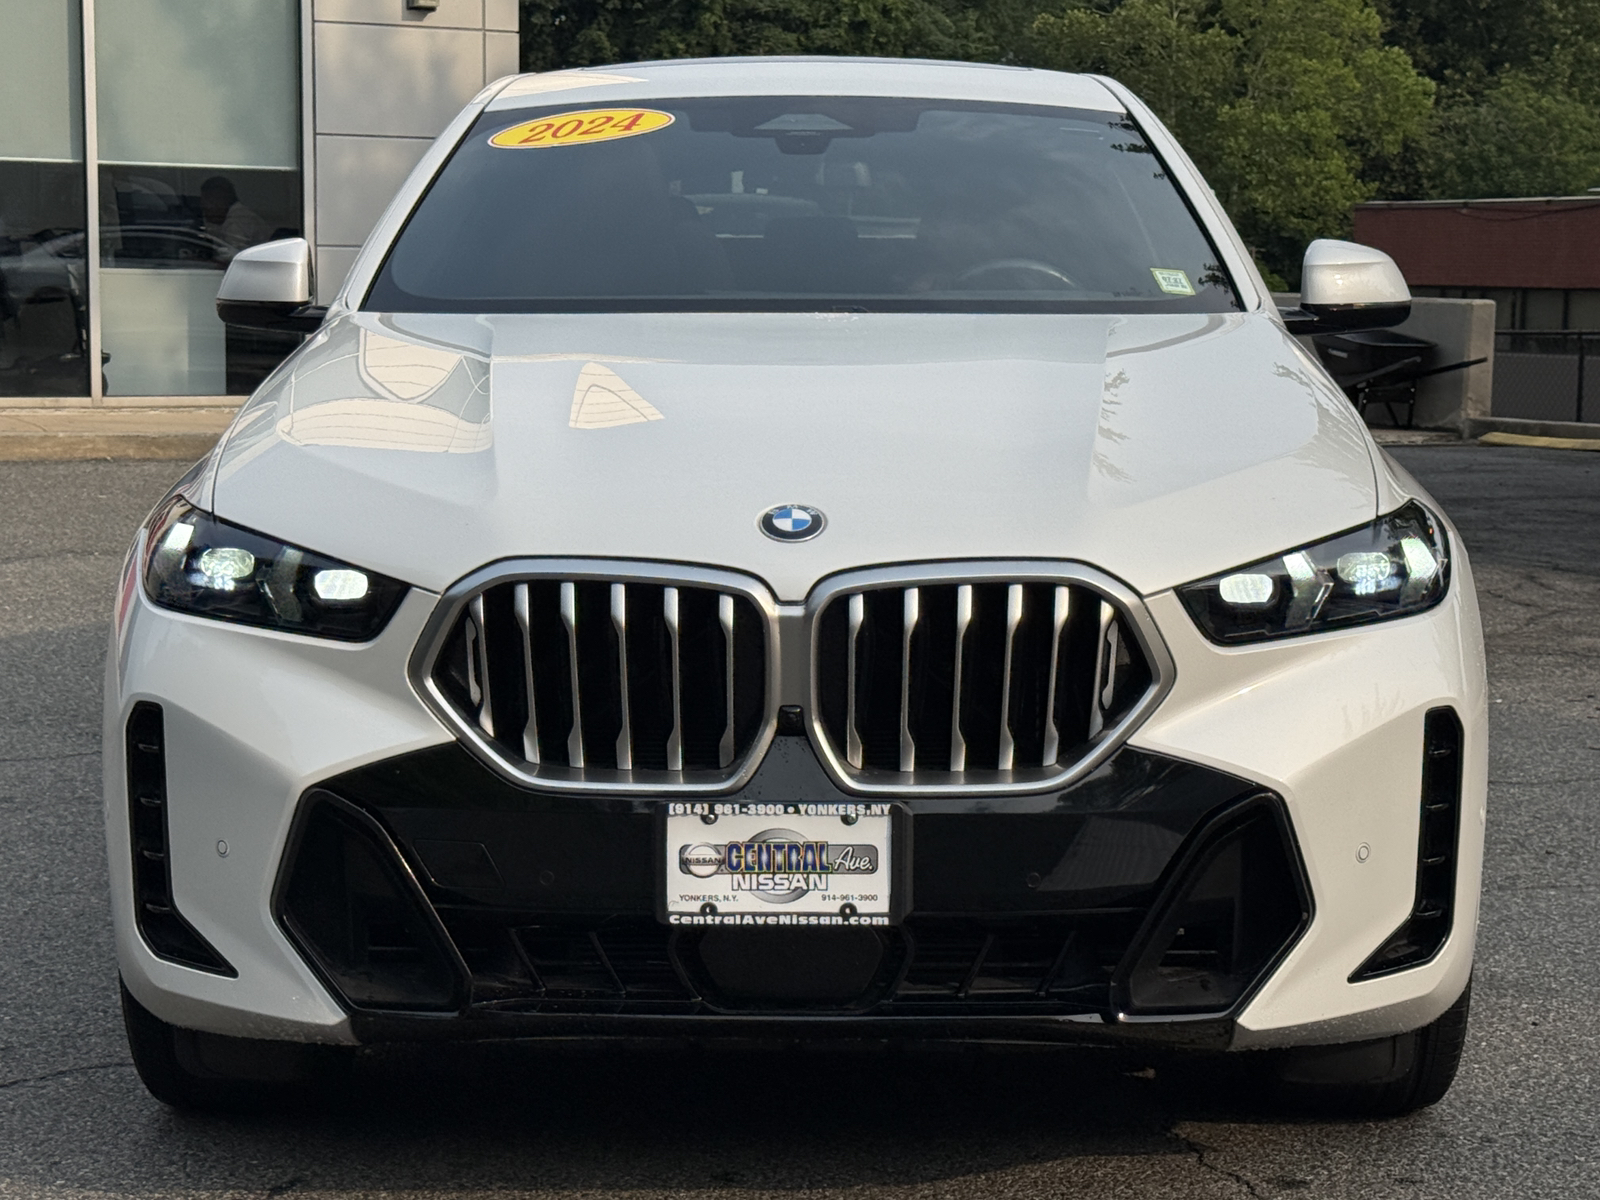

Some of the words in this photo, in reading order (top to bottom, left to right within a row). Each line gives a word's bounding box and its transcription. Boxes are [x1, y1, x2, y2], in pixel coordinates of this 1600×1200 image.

[518, 112, 645, 144] 2024
[714, 803, 784, 815] 961-3900
[685, 856, 721, 864] NISSAN
[725, 841, 833, 874] CENTRAL
[834, 846, 873, 871] Ave.
[731, 873, 828, 891] NISSAN
[679, 894, 721, 902] YONKERS,
[723, 894, 739, 902] N.Y.
[669, 914, 889, 925] CentralAveNissan.com
